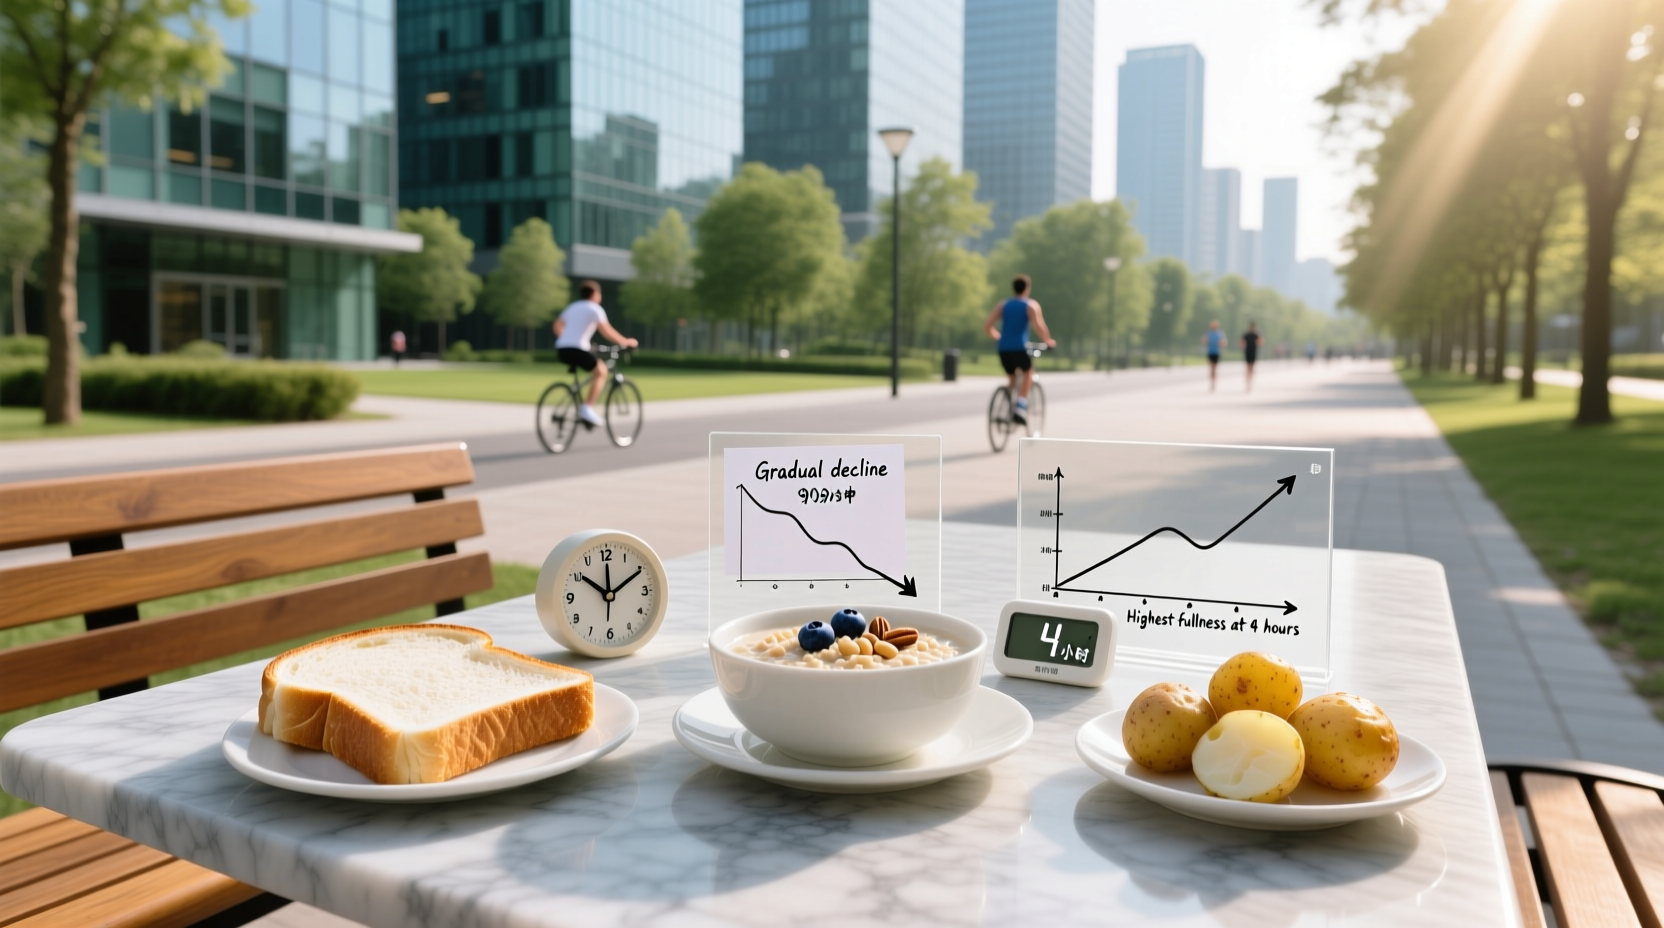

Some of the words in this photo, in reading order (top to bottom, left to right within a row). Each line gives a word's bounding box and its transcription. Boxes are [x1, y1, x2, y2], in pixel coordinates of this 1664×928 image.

[755, 459, 823, 482] Gradual
[830, 458, 889, 478] decline
[600, 548, 612, 562] 12
[641, 585, 649, 596] 3
[566, 592, 575, 604] 9
[1126, 609, 1175, 630] Highest
[1178, 611, 1226, 631] fullness
[1230, 616, 1247, 632] at
[1250, 619, 1258, 633] 4
[1263, 617, 1300, 636] hours
[606, 627, 614, 640] 6
